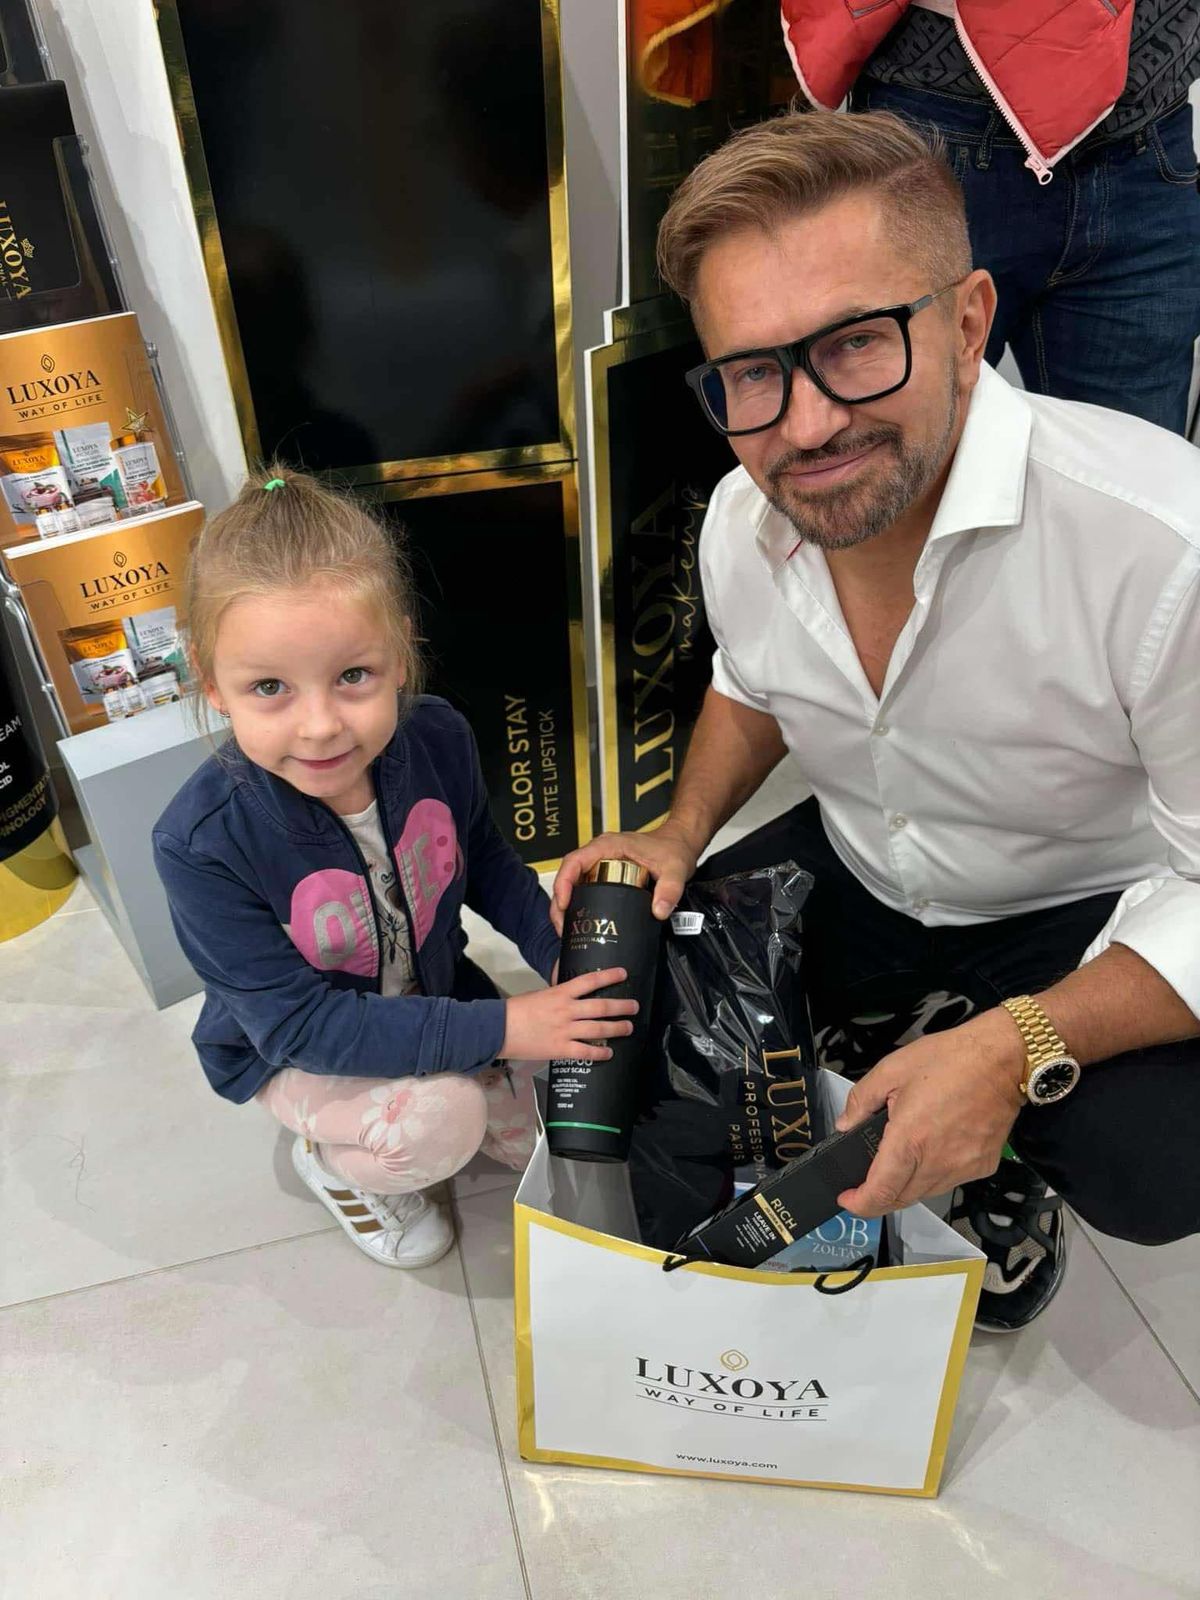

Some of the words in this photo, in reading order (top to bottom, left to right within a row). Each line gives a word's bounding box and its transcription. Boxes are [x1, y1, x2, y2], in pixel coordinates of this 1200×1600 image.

[7, 369, 102, 405] LUXOYA
[19, 406, 46, 420] WAY
[53, 401, 68, 411] OF
[76, 394, 103, 406] LIFE
[80, 561, 170, 598] LUXOYA
[91, 598, 116, 610] WAY
[123, 591, 137, 601] OF
[144, 582, 170, 595] LIFE
[631, 477, 676, 802] LUXOYA
[504, 695, 530, 753] STAY
[539, 709, 558, 785] LIPSTICK
[511, 760, 536, 841] COLOR
[544, 785, 560, 837] MATTE
[762, 1044, 813, 1162] LUXO
[729, 1123, 745, 1161] PARIS
[744, 1081, 767, 1180] PROFESSIONA
[754, 1211, 772, 1232] LEAVE
[768, 1231, 777, 1240] IN
[770, 1198, 797, 1230] RICH
[806, 1215, 869, 1248] OB
[635, 1356, 830, 1401] LUXOYA
[644, 1387, 695, 1406] WAY
[713, 1403, 745, 1413] OF
[763, 1408, 820, 1418] LIFE
[676, 1453, 778, 1470] www.luxoya.com
